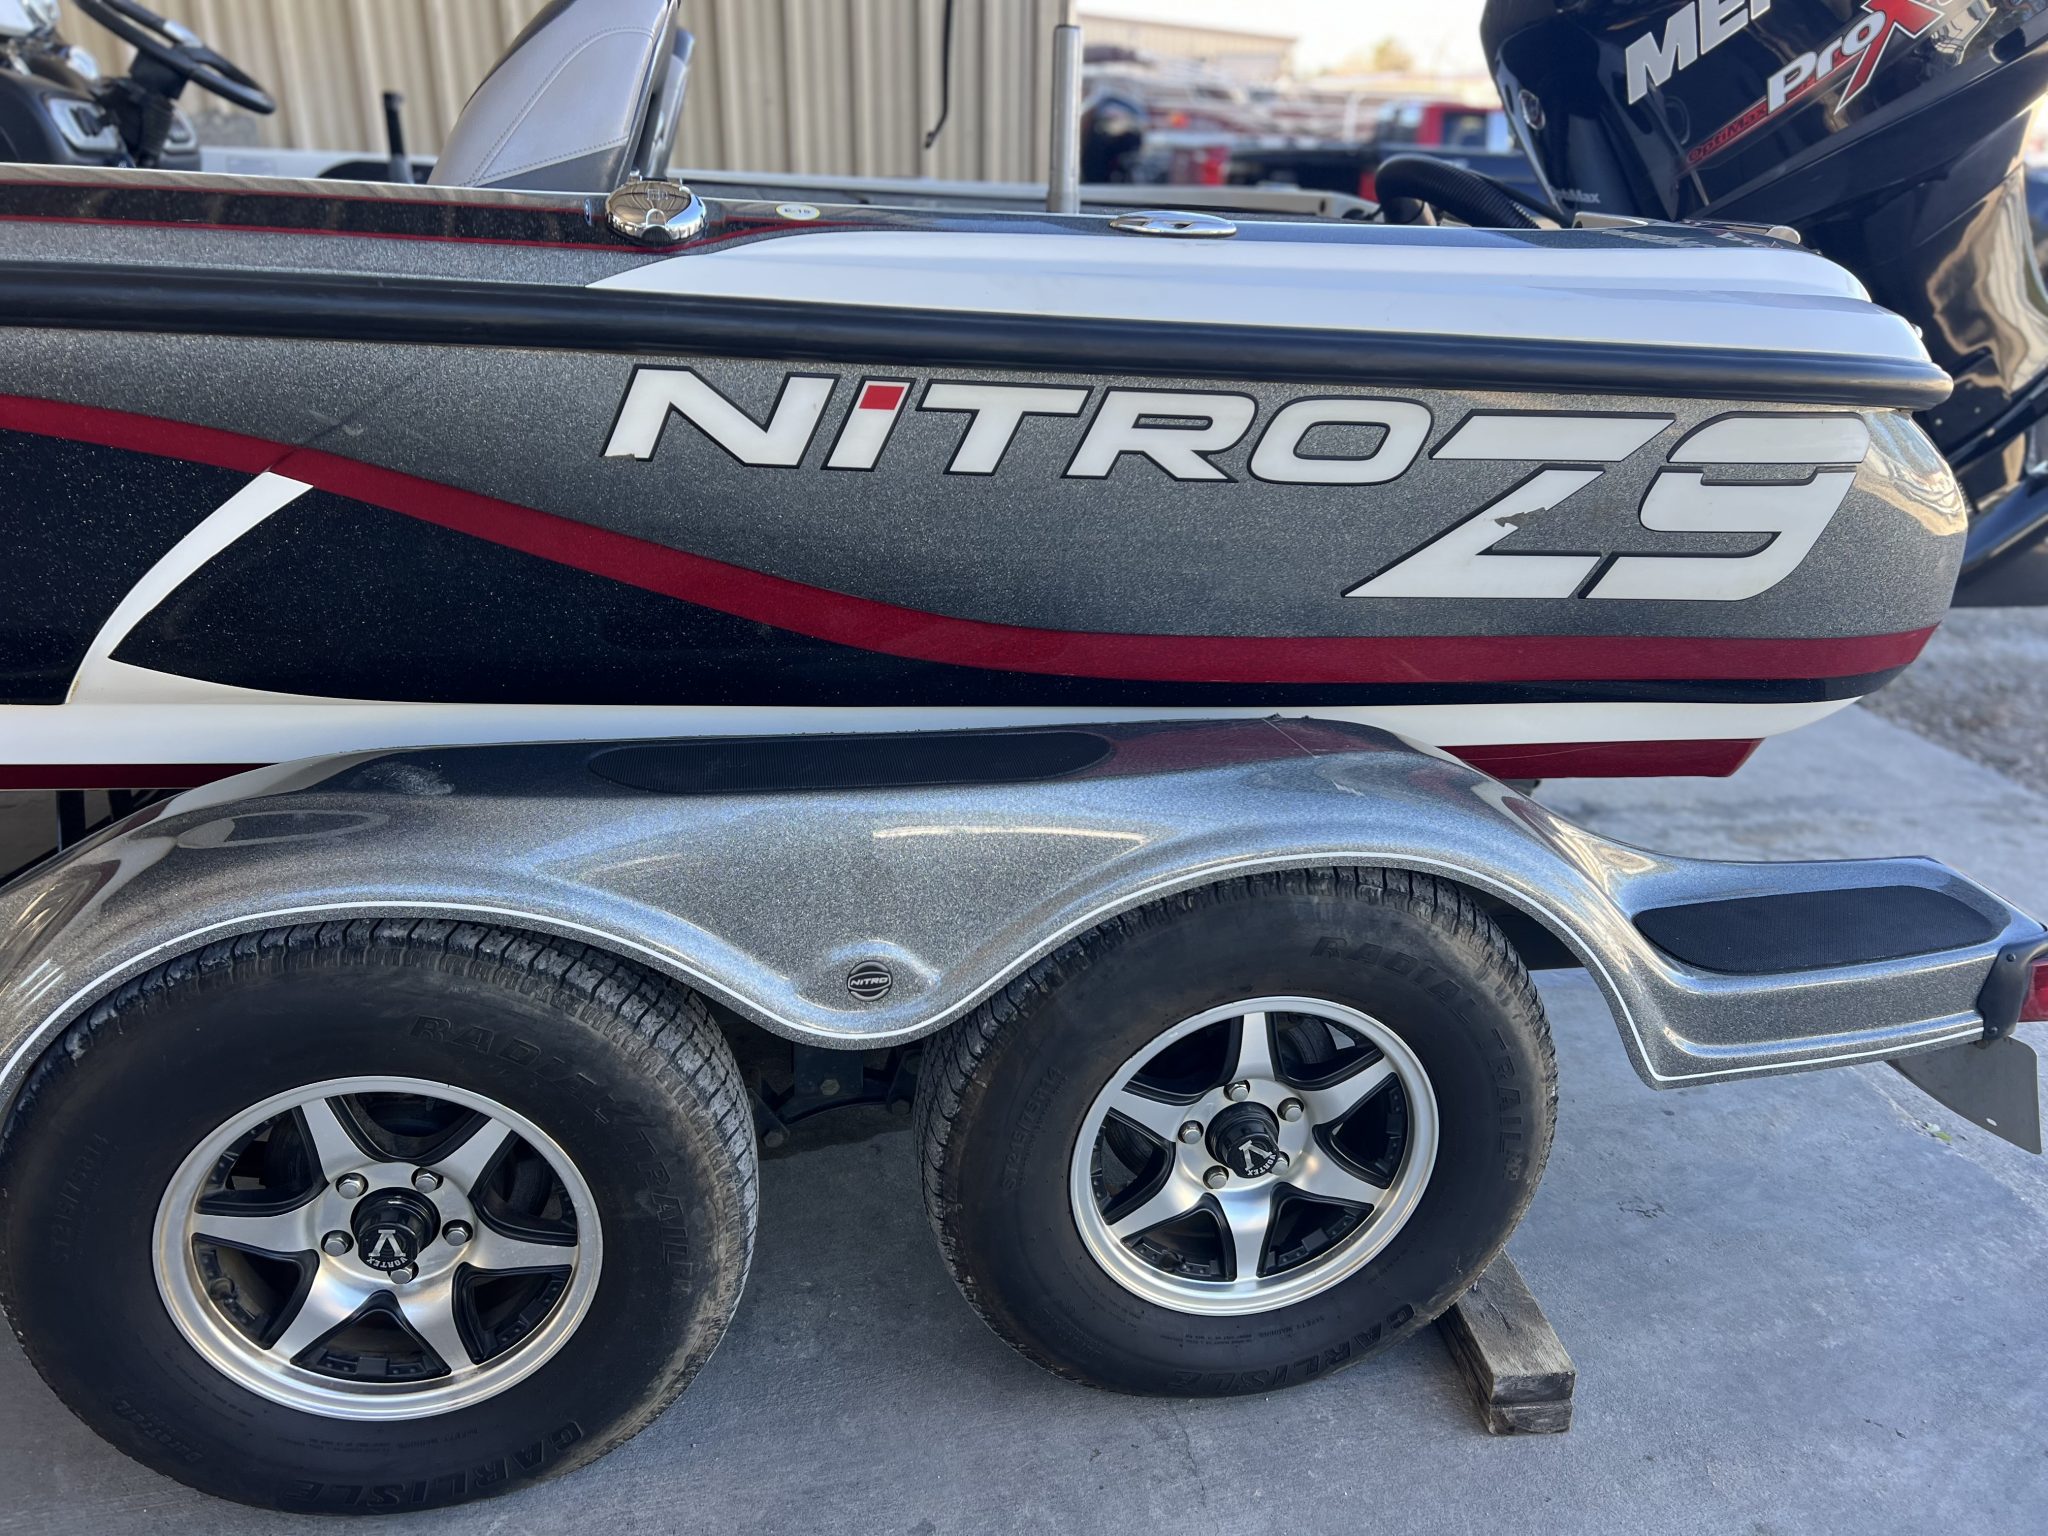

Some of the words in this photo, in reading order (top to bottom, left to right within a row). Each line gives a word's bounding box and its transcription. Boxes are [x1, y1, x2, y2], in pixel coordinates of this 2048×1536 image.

[1625, 0, 1771, 105] ME
[1340, 408, 1872, 601] Z9
[850, 976, 889, 987] NITRO
[1310, 935, 1476, 1026] RADIAL
[1247, 1154, 1277, 1176] VORTEX
[366, 1256, 409, 1269] VORTEX
